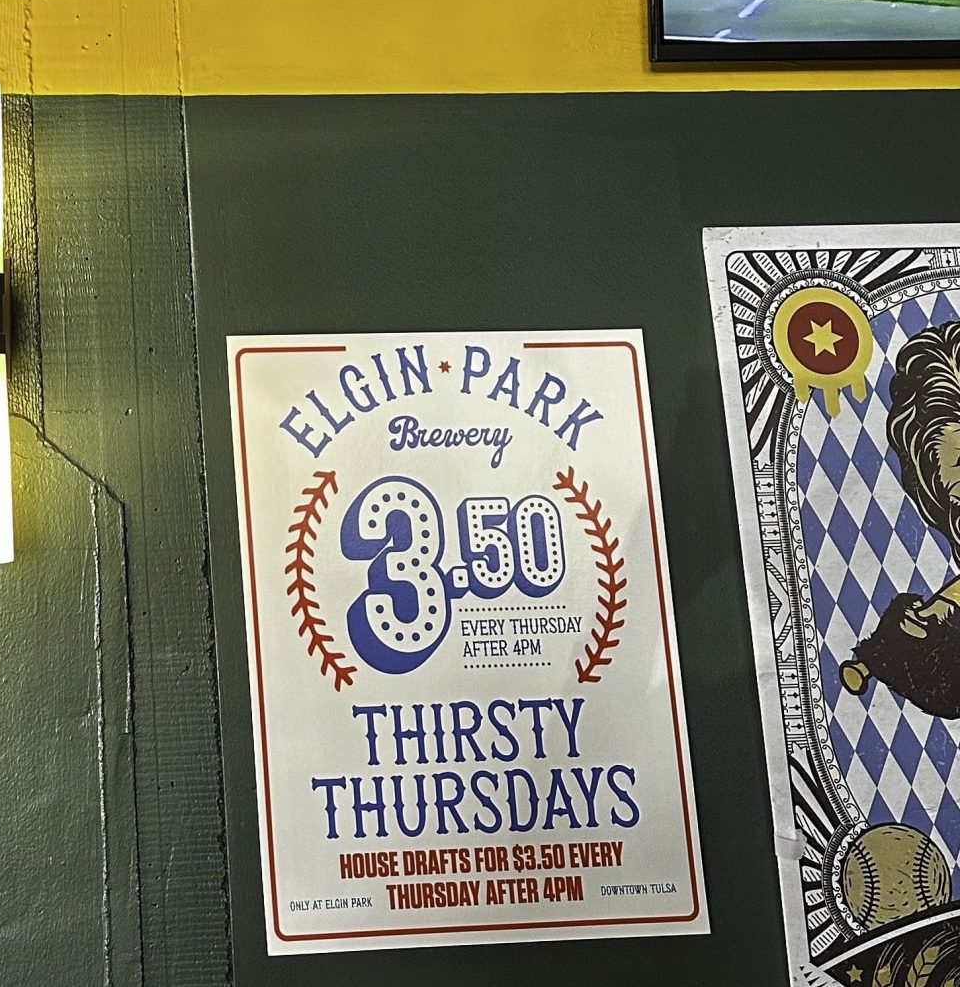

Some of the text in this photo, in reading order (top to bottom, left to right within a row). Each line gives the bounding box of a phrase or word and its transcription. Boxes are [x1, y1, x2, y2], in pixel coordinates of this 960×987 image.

[279, 344, 605, 459] ELGIN PARK
[388, 415, 513, 469] Brewery
[339, 475, 566, 675] 3.50
[460, 616, 583, 637] EVERY THURSDAY
[463, 638, 542, 658] AFTER 4PM
[352, 697, 585, 766] THIRSTY
[311, 764, 640, 840] THURSDAYS
[339, 841, 624, 880] HOUSE DRAFTS FOR $3.50 EVERY
[289, 897, 373, 912] ONLY AT ELGIN PARK
[386, 875, 584, 911] THURSDAY AFTER 4PM
[600, 883, 677, 896] DOWNTOWN TULSA
